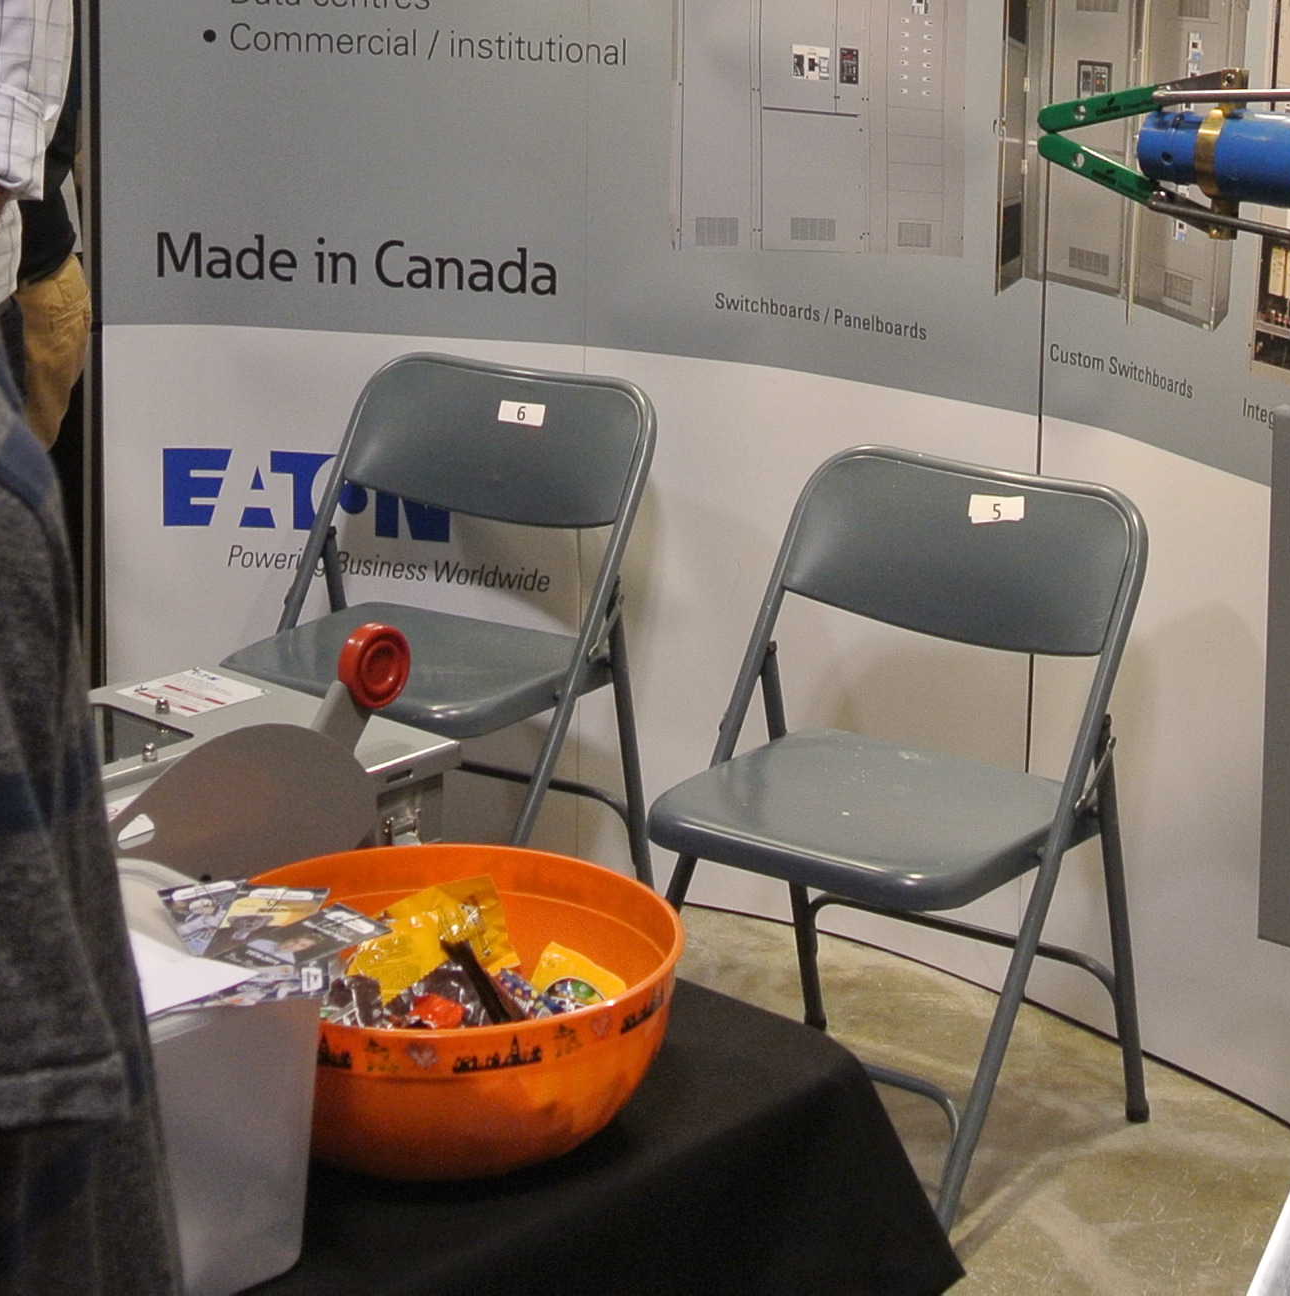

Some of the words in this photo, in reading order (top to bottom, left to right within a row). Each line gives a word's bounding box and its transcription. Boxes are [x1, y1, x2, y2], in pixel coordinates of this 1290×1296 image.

[229, 22, 419, 58] Commercial
[449, 30, 627, 66] institutional
[156, 231, 298, 283] Made
[314, 237, 358, 285] in
[375, 240, 558, 296] Canada
[714, 292, 820, 323] Switchboards
[834, 308, 927, 341] Panelboards
[1049, 343, 1105, 372] Custom
[1109, 356, 1194, 399] Switchboards
[516, 404, 526, 421] 6
[992, 503, 1002, 520] 5
[227, 545, 325, 578] Powerig
[337, 551, 428, 582] Business
[434, 560, 550, 593] Worldwide
